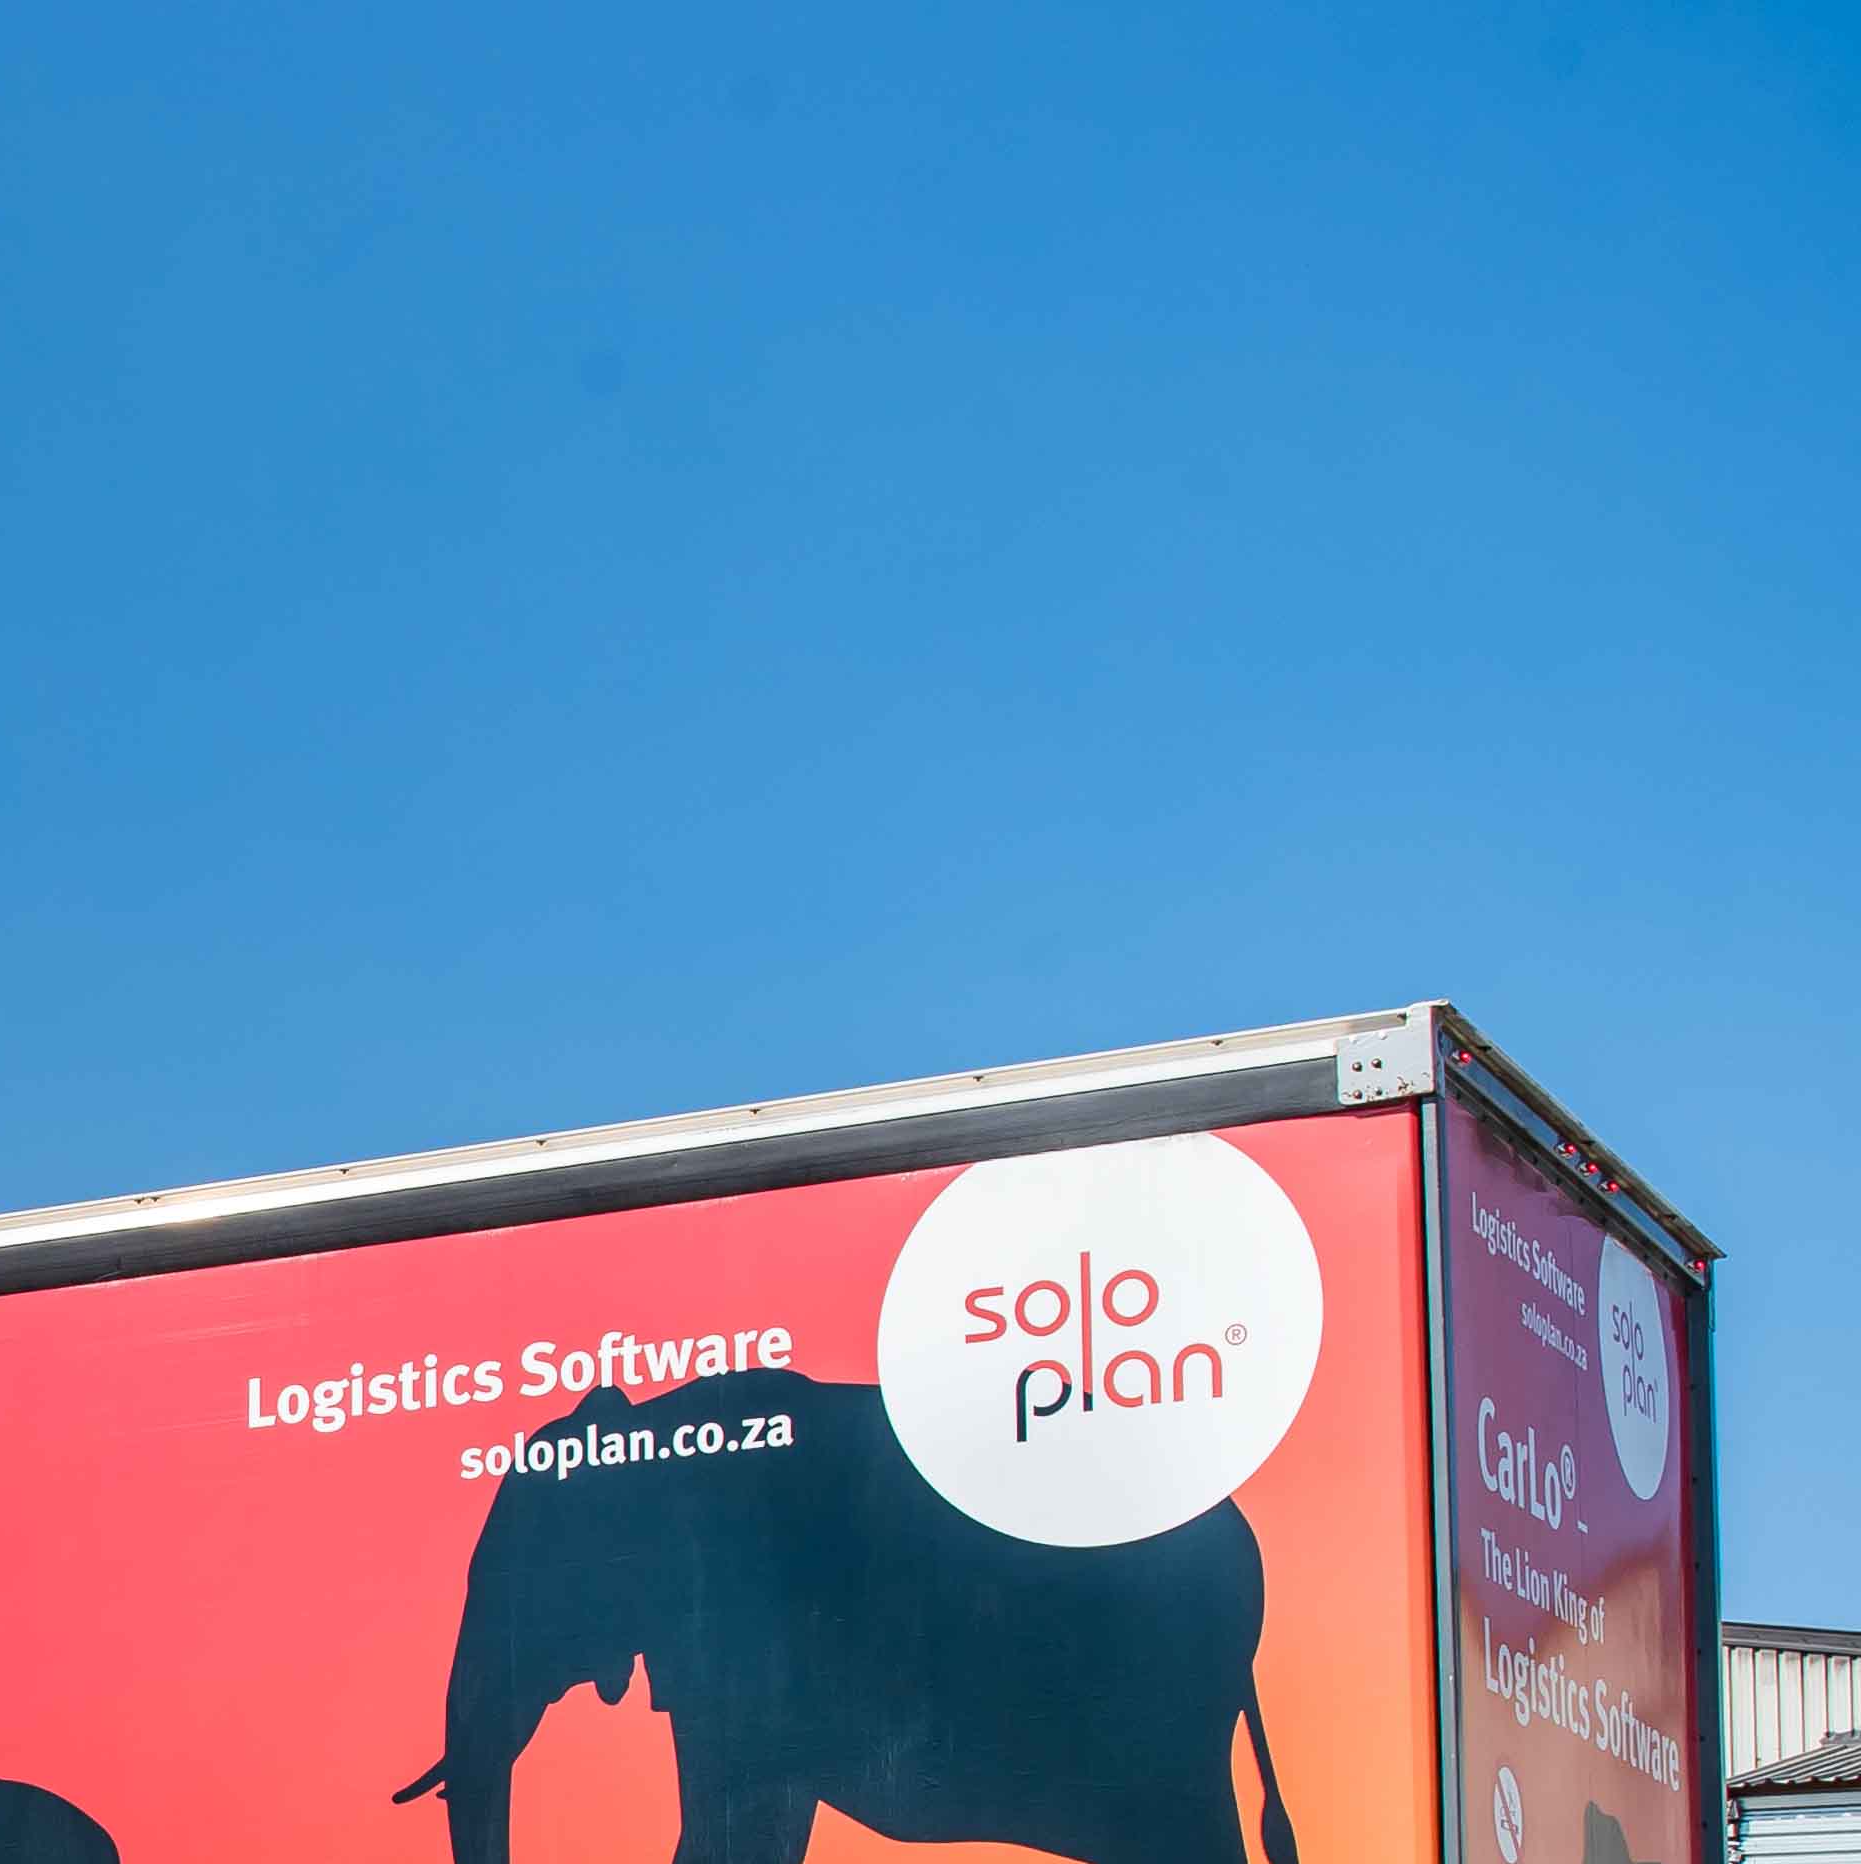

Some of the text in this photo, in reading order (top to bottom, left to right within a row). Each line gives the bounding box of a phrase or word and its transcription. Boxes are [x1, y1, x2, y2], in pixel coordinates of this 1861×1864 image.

[965, 1251, 1159, 1344] solo
[1472, 1191, 1586, 1317] Logistics Software
[249, 1328, 791, 1432] Logistics Software
[1521, 1302, 1589, 1371] soloplan.co.za
[1612, 1301, 1644, 1361] solo
[461, 1415, 793, 1480] soloplan.co.za
[1481, 1527, 1605, 1646] The Lion King of
[1484, 1615, 1679, 1792] Logistics Software
